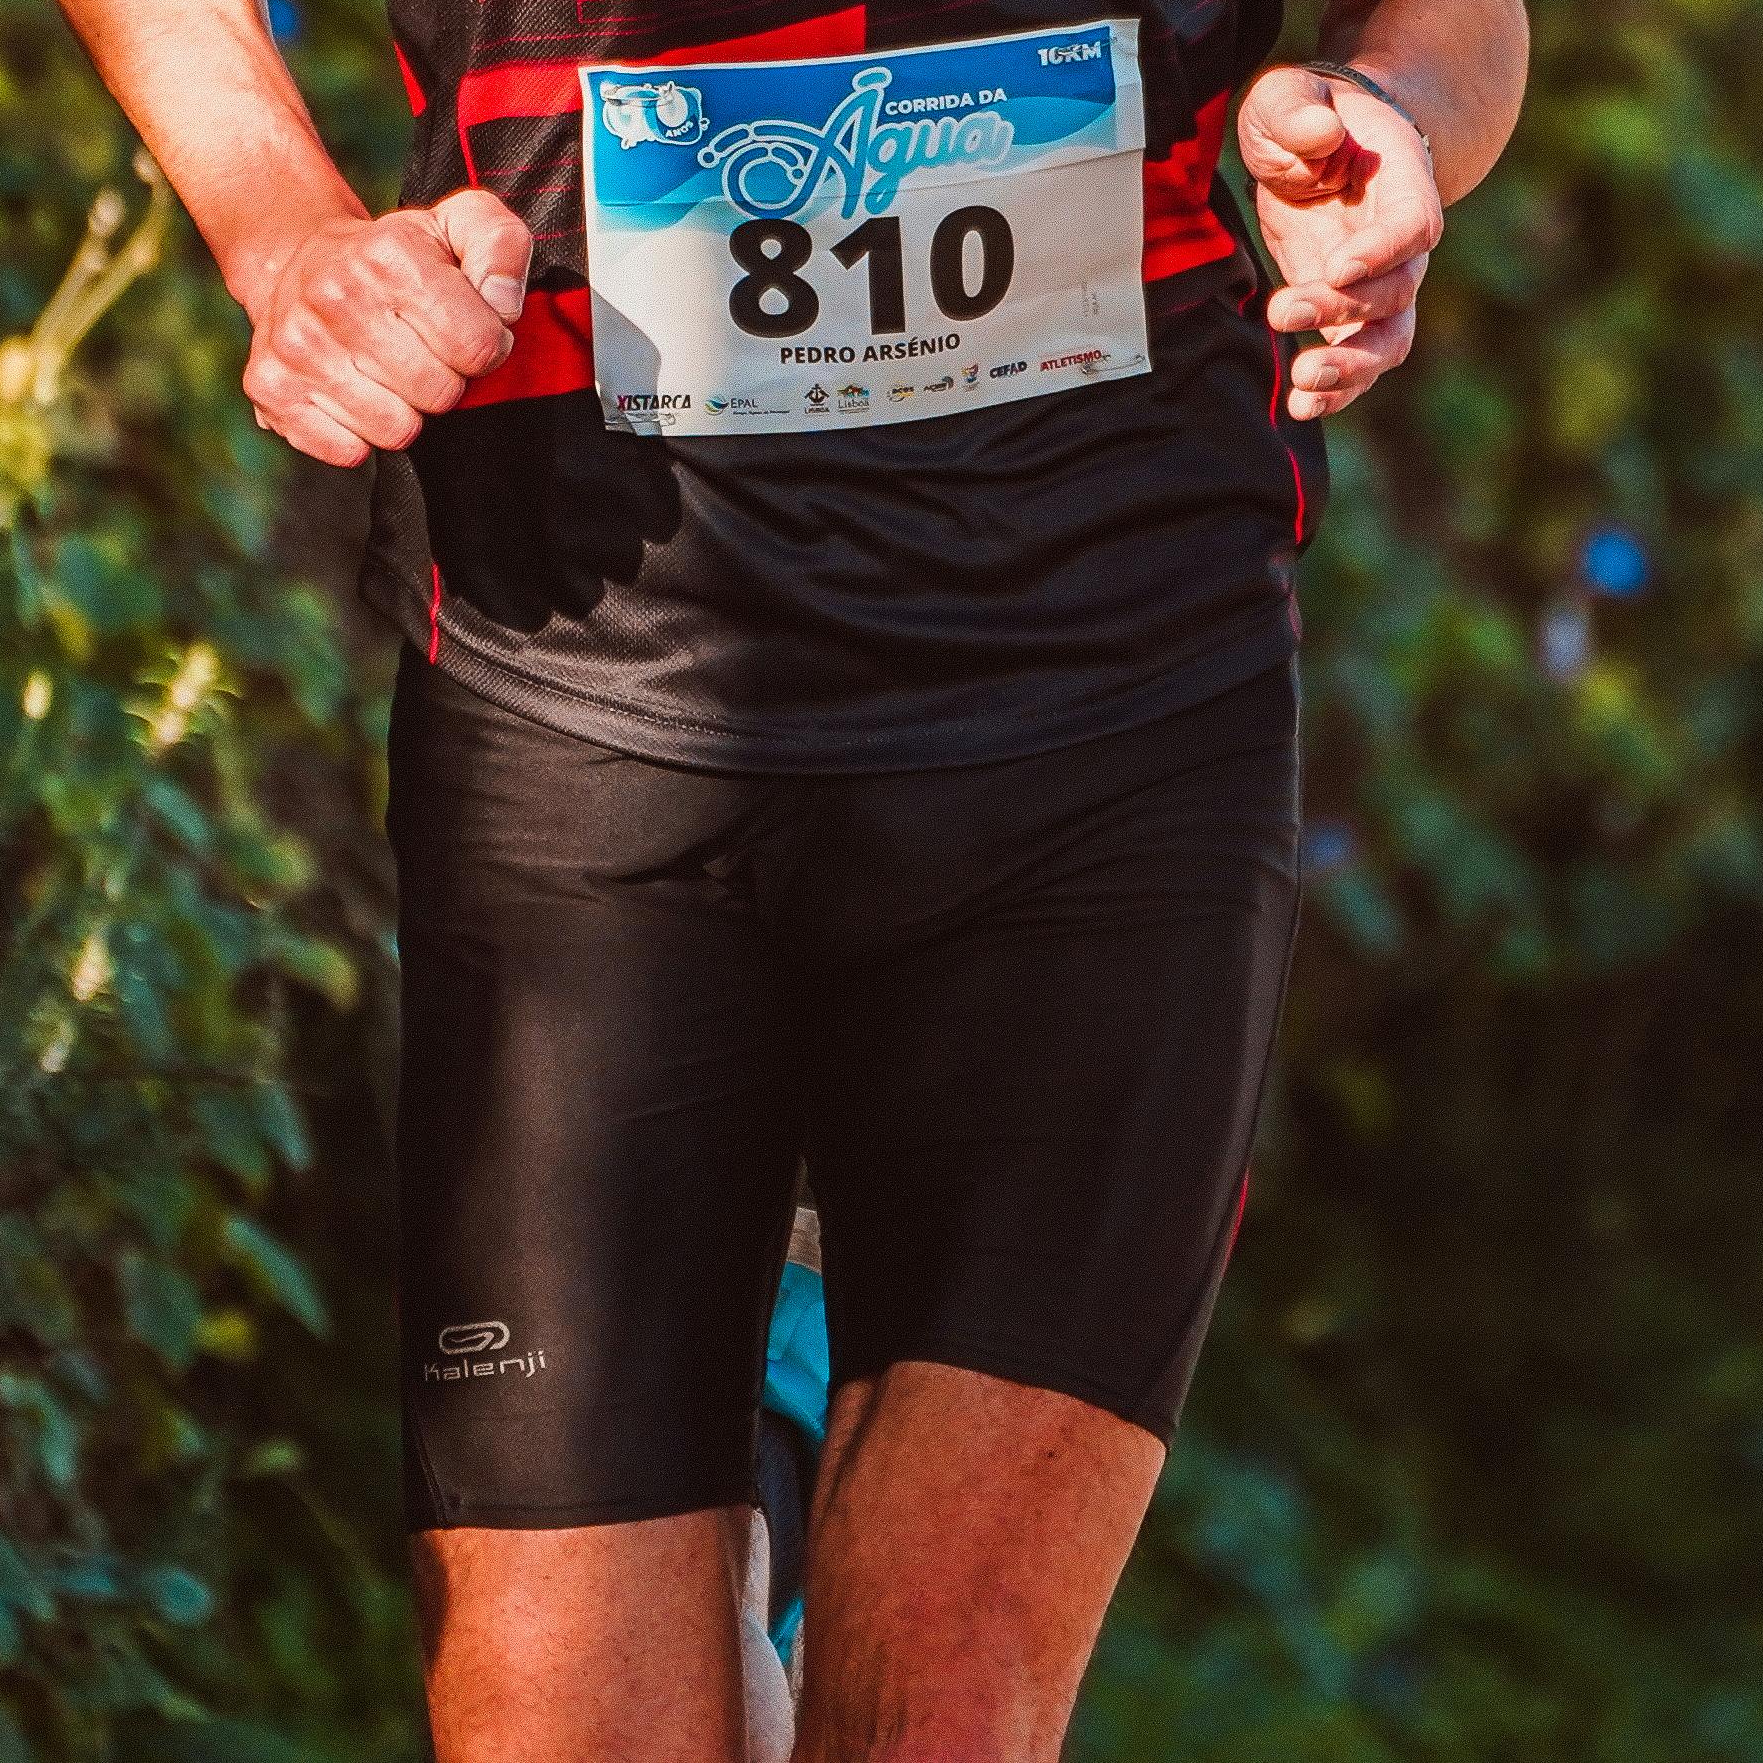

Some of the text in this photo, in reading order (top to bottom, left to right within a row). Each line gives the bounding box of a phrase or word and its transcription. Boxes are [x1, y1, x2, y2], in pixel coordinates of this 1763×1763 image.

[885, 87, 1008, 116] CORRIDA DA
[697, 66, 1014, 221] Água
[729, 205, 1015, 338] 810
[780, 333, 961, 365] PEDRO ARSÉNIO
[1040, 349, 1103, 372] ATLETISMO
[617, 394, 692, 412] XISTARCA
[730, 397, 758, 409] EPAL
